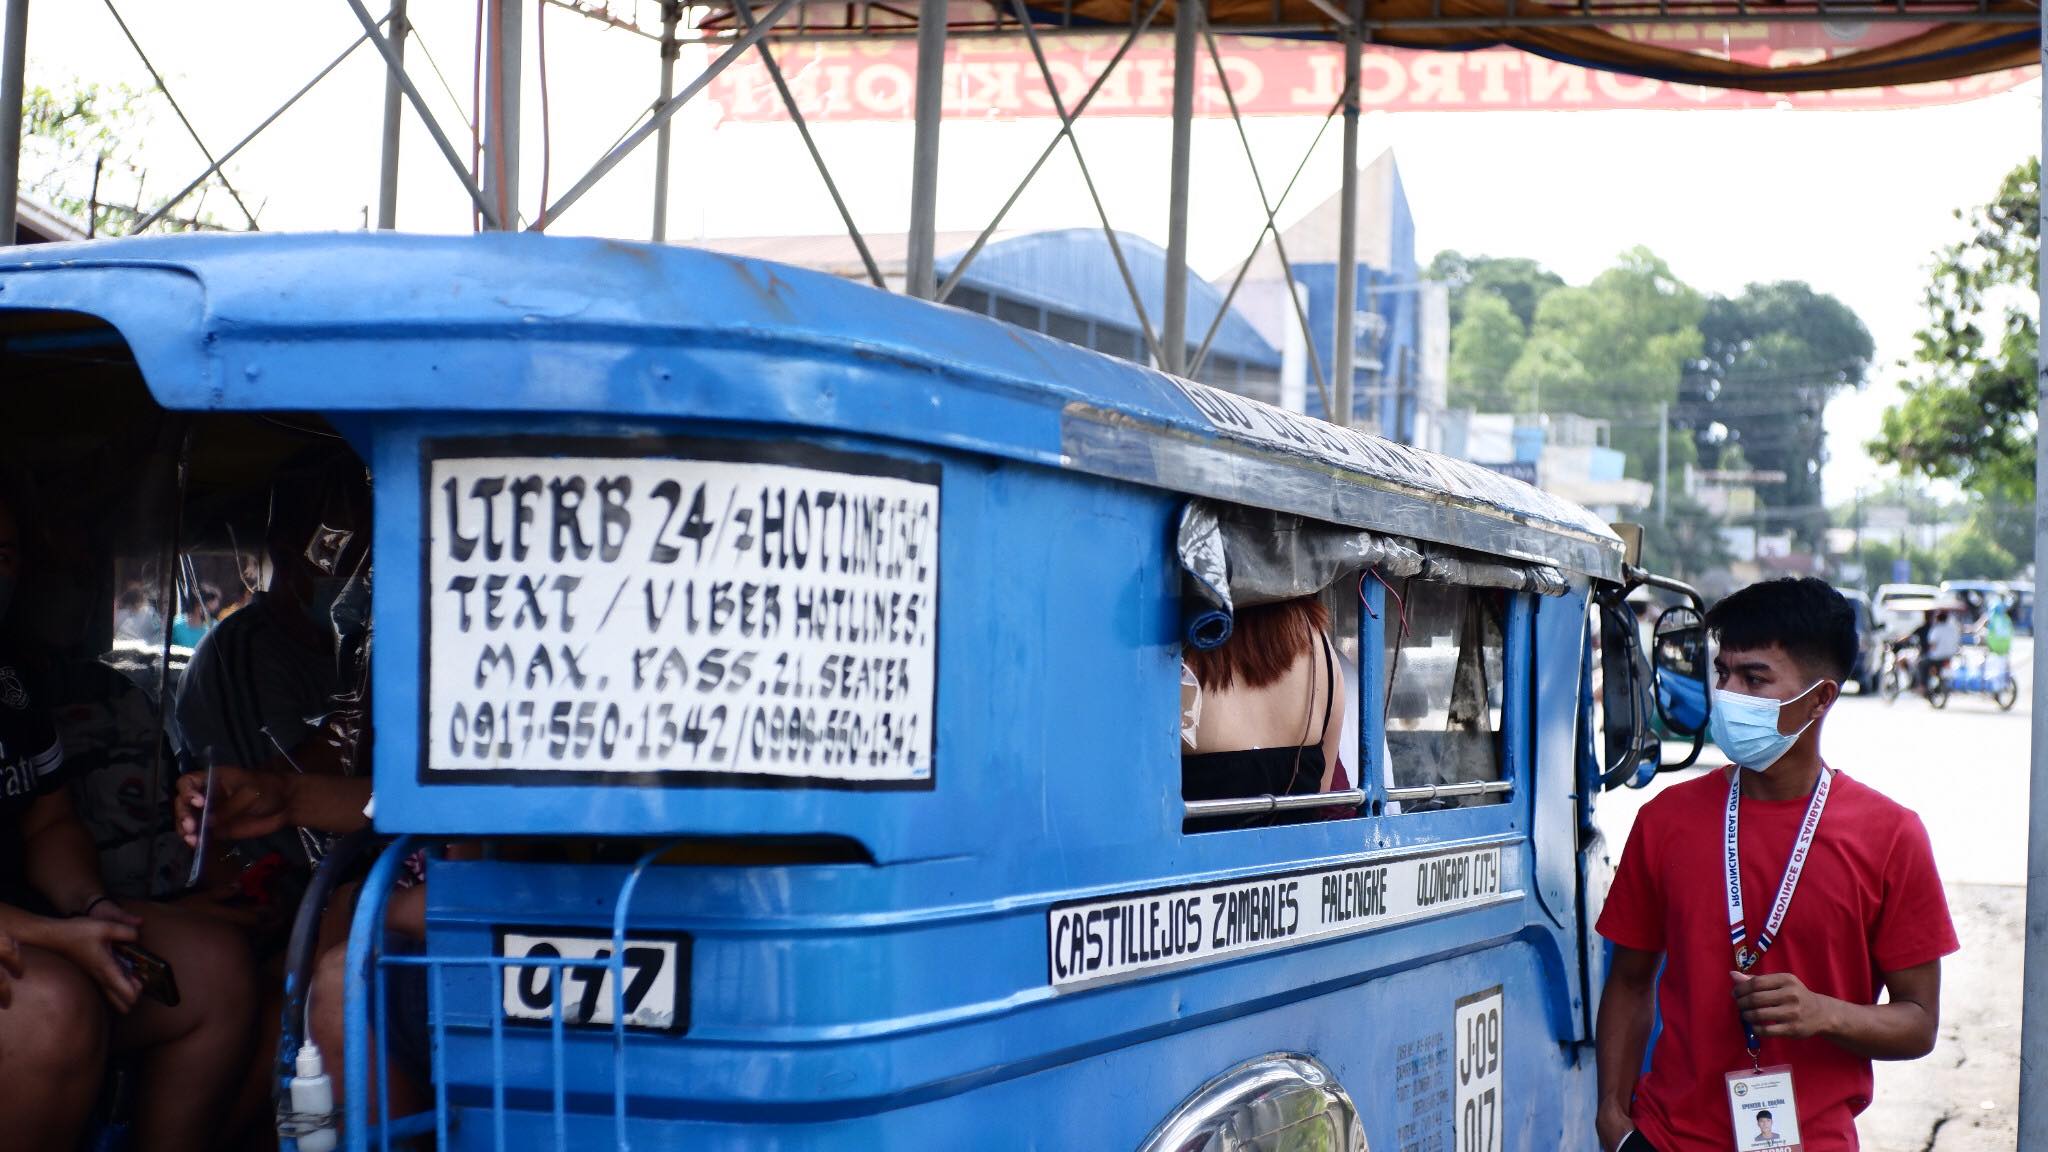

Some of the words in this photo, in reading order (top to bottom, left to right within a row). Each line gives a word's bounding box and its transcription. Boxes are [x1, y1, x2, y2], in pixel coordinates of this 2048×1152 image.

[442, 474, 633, 563] LTFRB
[447, 574, 582, 633] TEXT
[643, 578, 782, 638] VIBER
[475, 642, 609, 691] MAX.
[1055, 896, 1201, 979] CASTILLEJOS
[1212, 881, 1299, 949] ZAMBALES
[1321, 867, 1388, 924] PALENGKE
[1416, 855, 1470, 907] OLONGAPO
[1473, 851, 1497, 896] CITY
[518, 942, 665, 1023] 017
